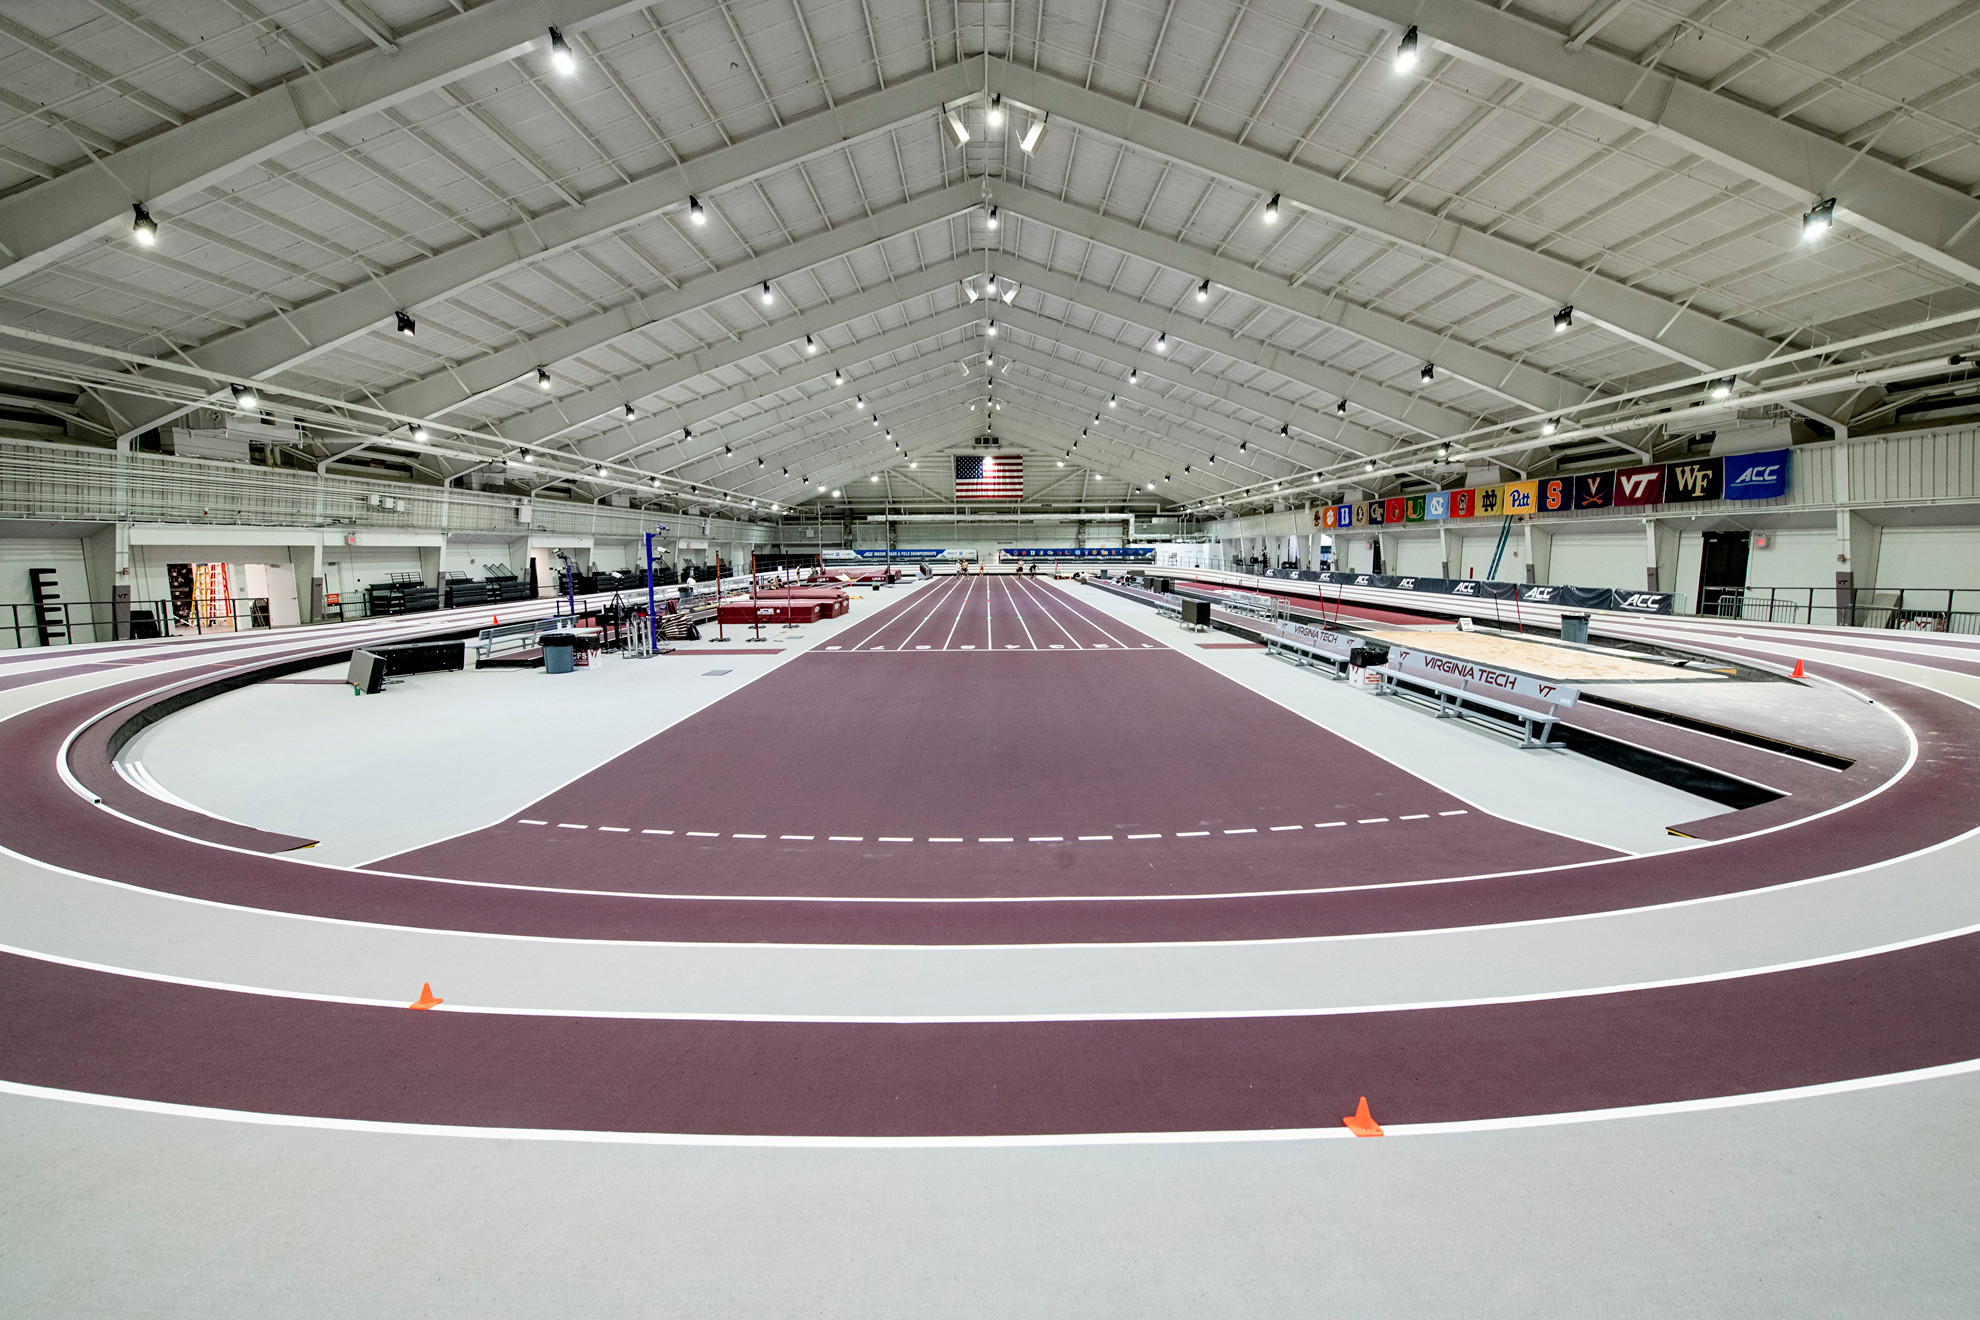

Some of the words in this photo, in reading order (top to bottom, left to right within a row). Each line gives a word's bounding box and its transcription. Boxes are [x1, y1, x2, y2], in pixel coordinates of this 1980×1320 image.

[1675, 464, 1713, 497] WF
[1734, 464, 1781, 484] ACC
[1546, 480, 1563, 509] S
[1587, 476, 1601, 497] V
[1619, 472, 1659, 499] VT
[1509, 489, 1531, 508] Pitt
[1407, 499, 1424, 519] U
[1320, 572, 1331, 581] ACC
[1355, 575, 1370, 585] ACC
[1399, 578, 1416, 588] ACC
[1454, 582, 1476, 592] ACC
[1525, 586, 1552, 598] ACC
[1624, 594, 1663, 608] ACC
[1294, 626, 1320, 640] VIRGINIA
[1320, 631, 1338, 645] TECH
[1346, 638, 1356, 647] VT
[1400, 650, 1410, 661] VT
[1424, 656, 1475, 680] VIRGINIA
[1478, 668, 1518, 690] TECH
[1538, 684, 1557, 698] VT
